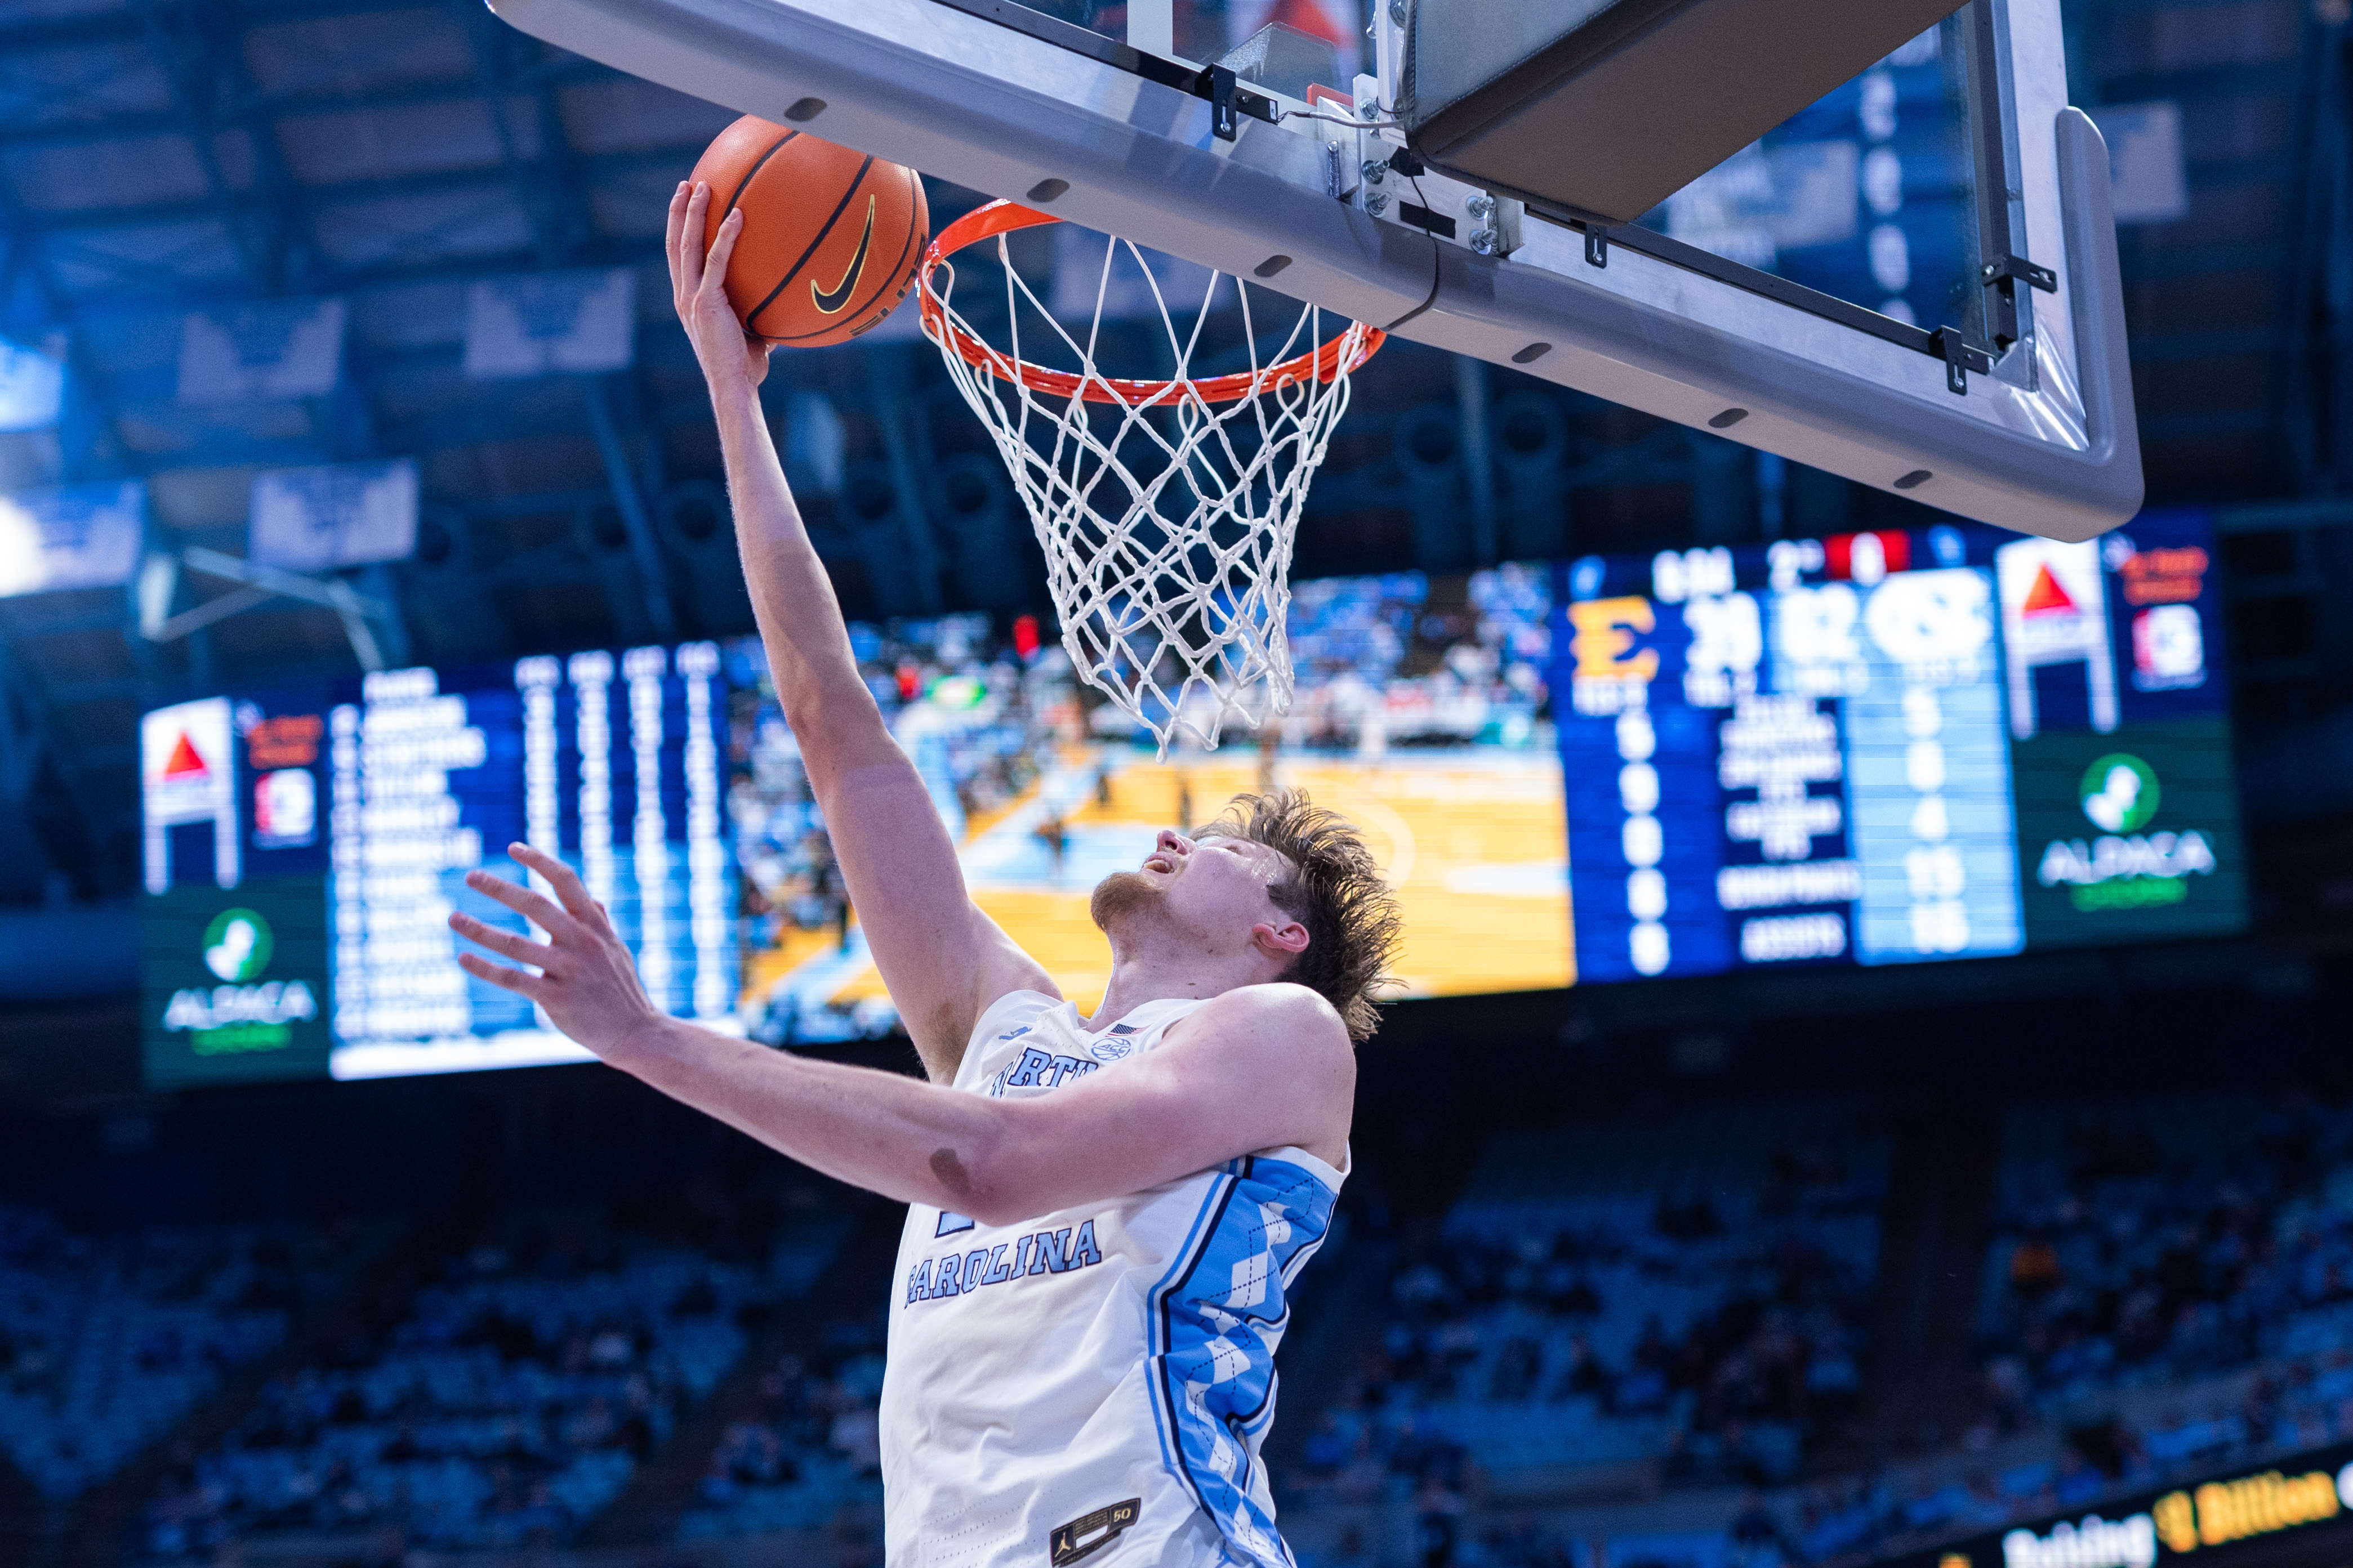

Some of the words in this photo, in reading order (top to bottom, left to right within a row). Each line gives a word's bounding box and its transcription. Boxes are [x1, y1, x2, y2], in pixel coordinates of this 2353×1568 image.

[1100, 1044, 1128, 1054] ACC
[990, 1047, 1099, 1098] NRT
[1113, 1507, 1131, 1523] 50
